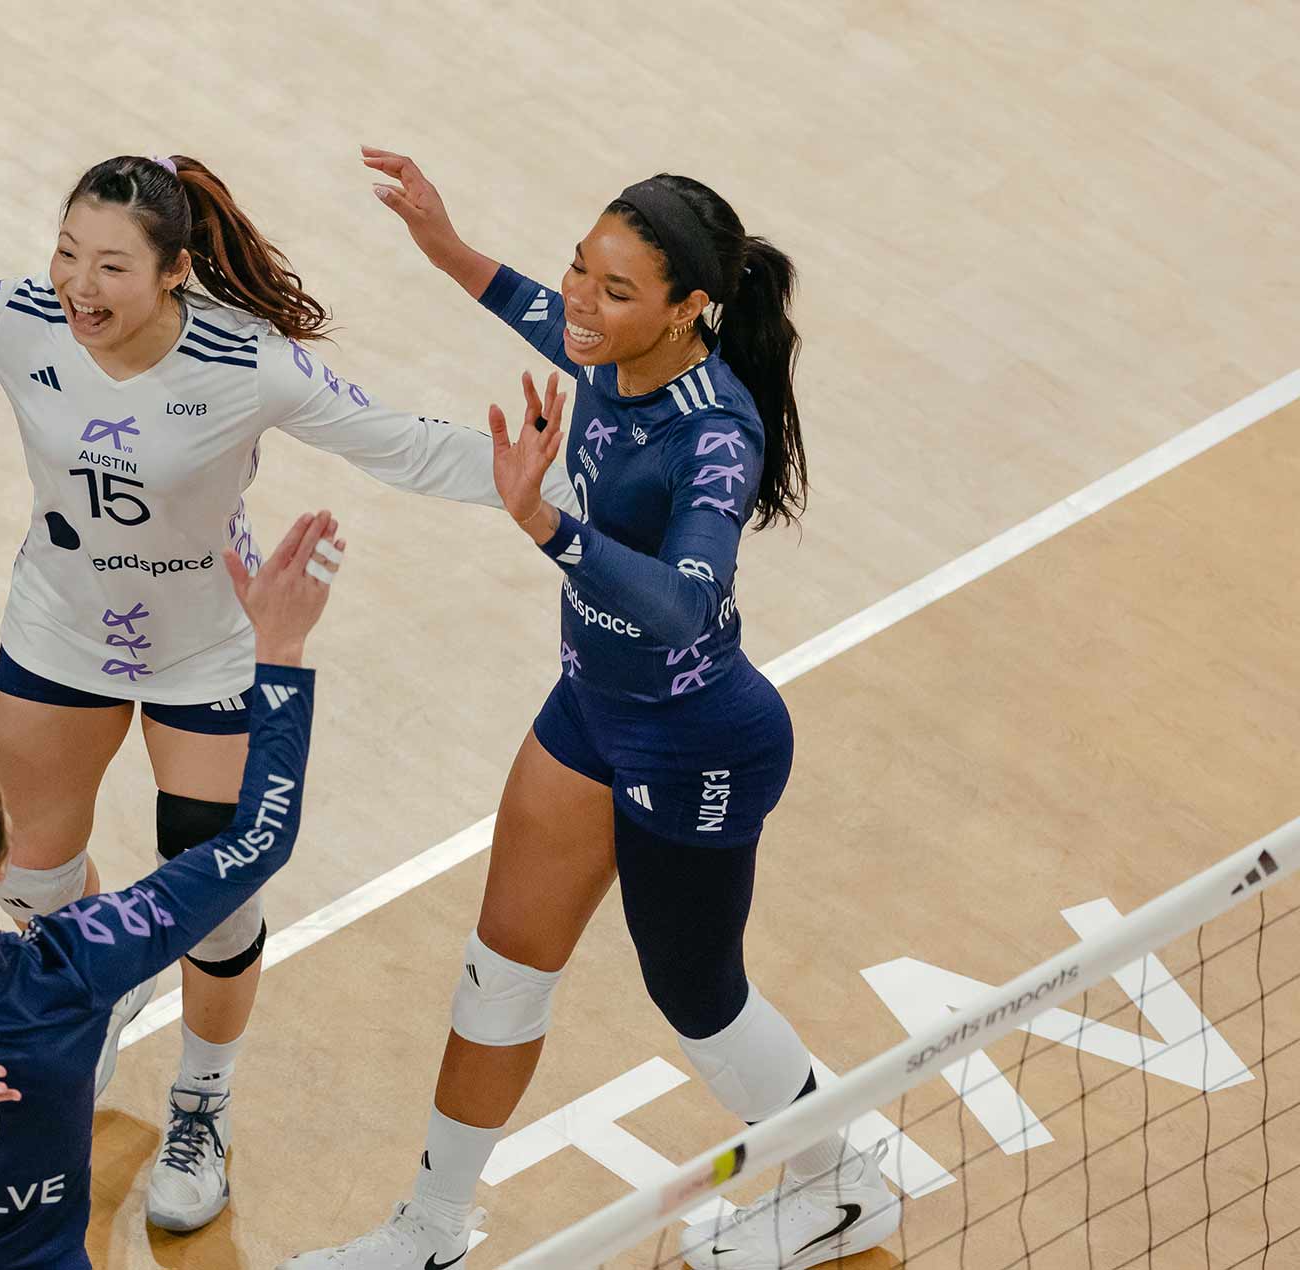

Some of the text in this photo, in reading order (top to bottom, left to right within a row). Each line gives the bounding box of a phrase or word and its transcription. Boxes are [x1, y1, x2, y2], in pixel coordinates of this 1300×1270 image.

[166, 402, 207, 416] LOVB
[78, 450, 137, 474] AUSTIN
[577, 445, 600, 483] AUSTIN
[69, 468, 150, 526] 15
[91, 553, 214, 577] eadspace
[563, 574, 641, 638] eadspace
[213, 774, 295, 879] AUSTIN
[906, 964, 1080, 1073] sports imports
